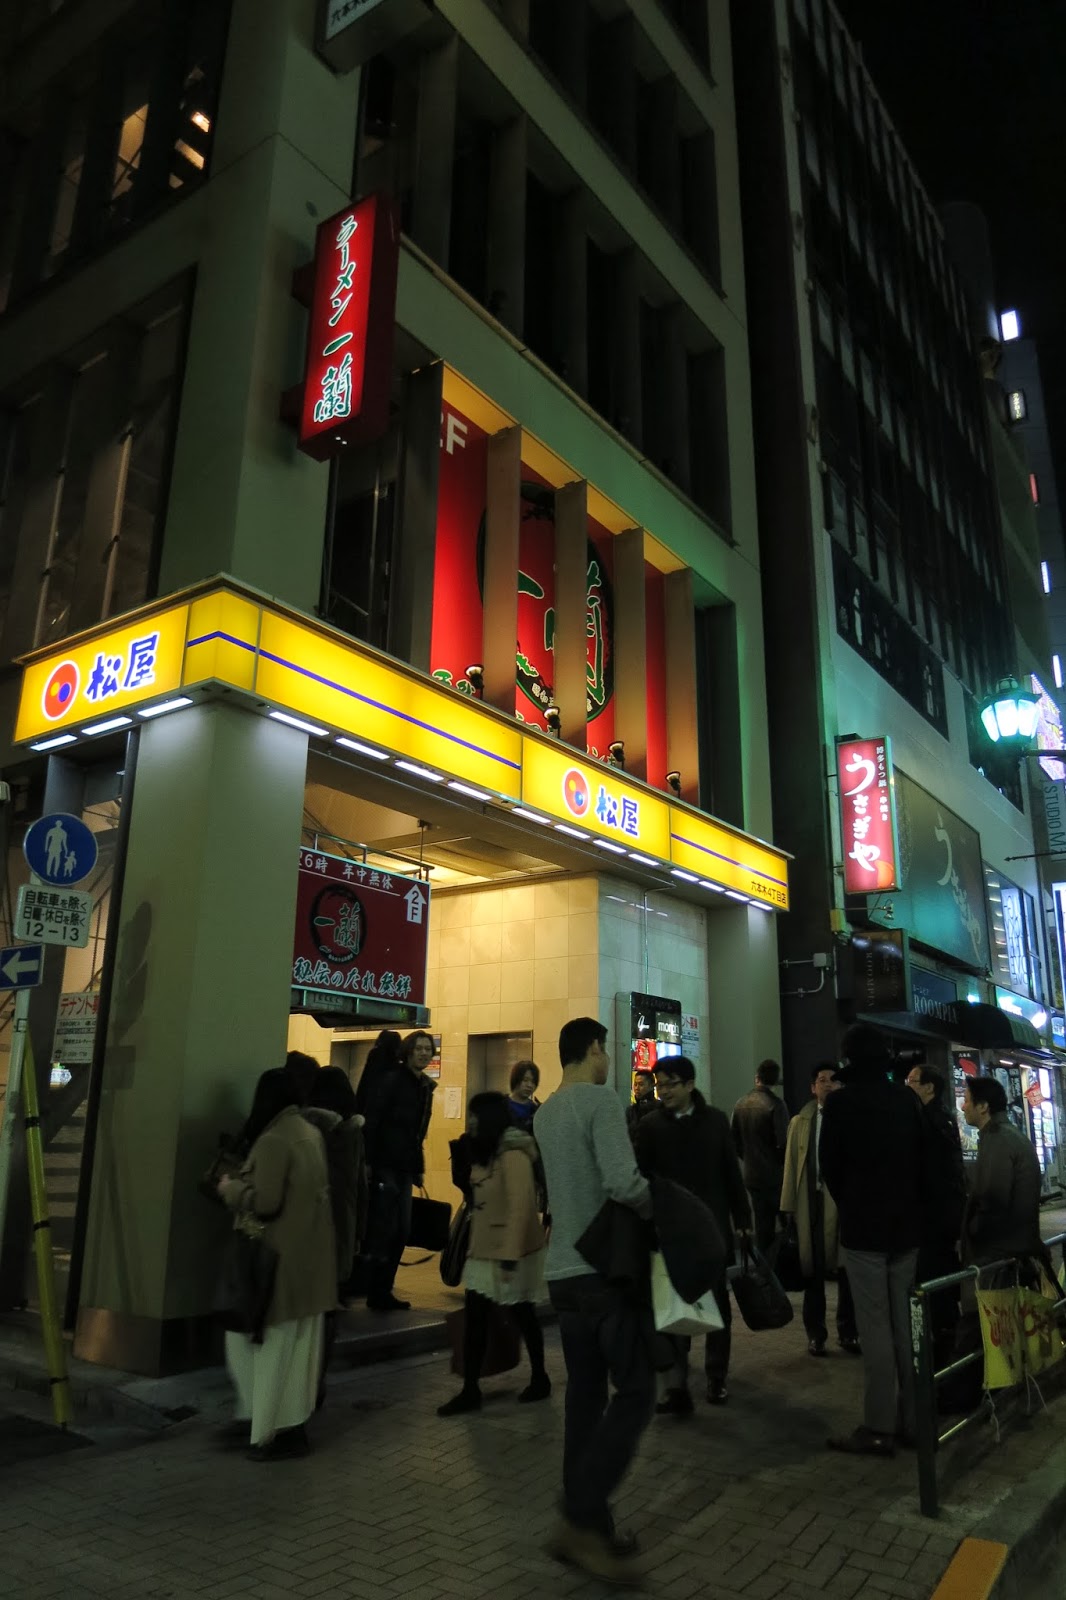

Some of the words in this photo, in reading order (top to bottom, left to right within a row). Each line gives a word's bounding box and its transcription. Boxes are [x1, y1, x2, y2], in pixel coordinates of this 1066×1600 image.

[440, 412, 468, 456] F
[85, 631, 161, 702] 松屋
[595, 784, 640, 839] 松屋
[843, 752, 880, 872] うさぎや
[1044, 785, 1062, 829] STUDIO
[25, 890, 88, 912] 自転車を除く
[342, 863, 394, 890] 年中無休
[314, 901, 361, 955] 一蘭
